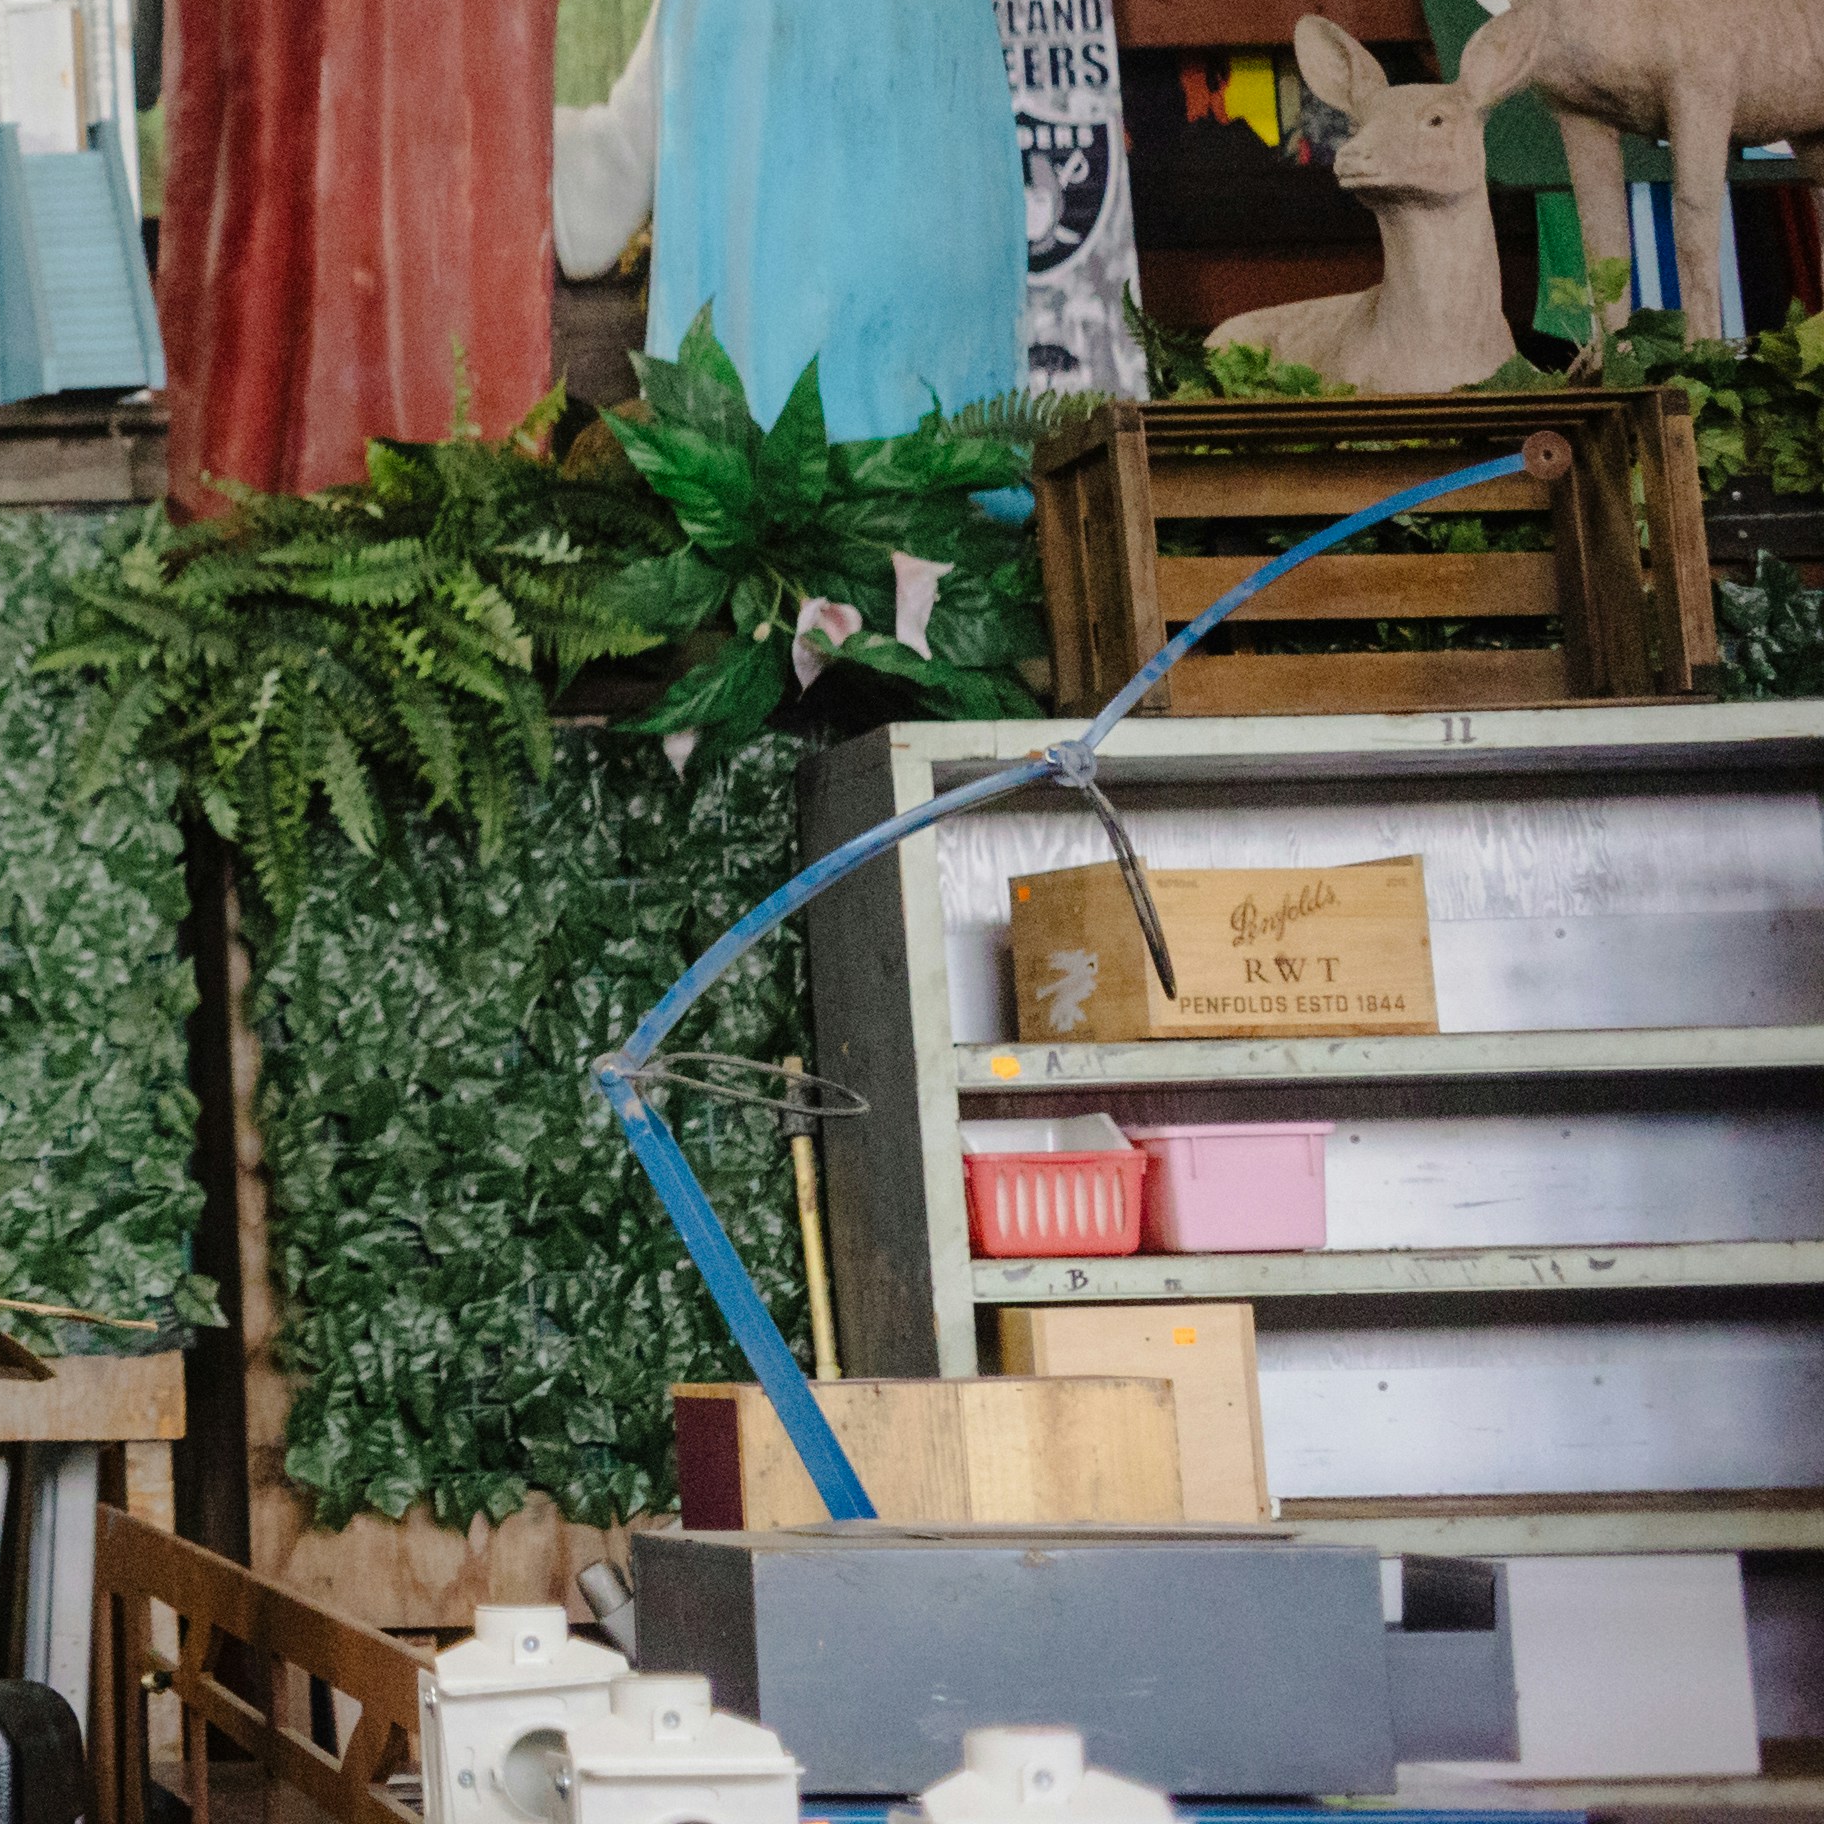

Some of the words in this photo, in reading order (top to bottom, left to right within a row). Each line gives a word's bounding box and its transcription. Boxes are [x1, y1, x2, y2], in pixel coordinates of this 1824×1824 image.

[1180, 996, 1287, 1014] PENFOLDS
[1297, 995, 1349, 1014] ESTD
[1357, 994, 1407, 1013] 1844
